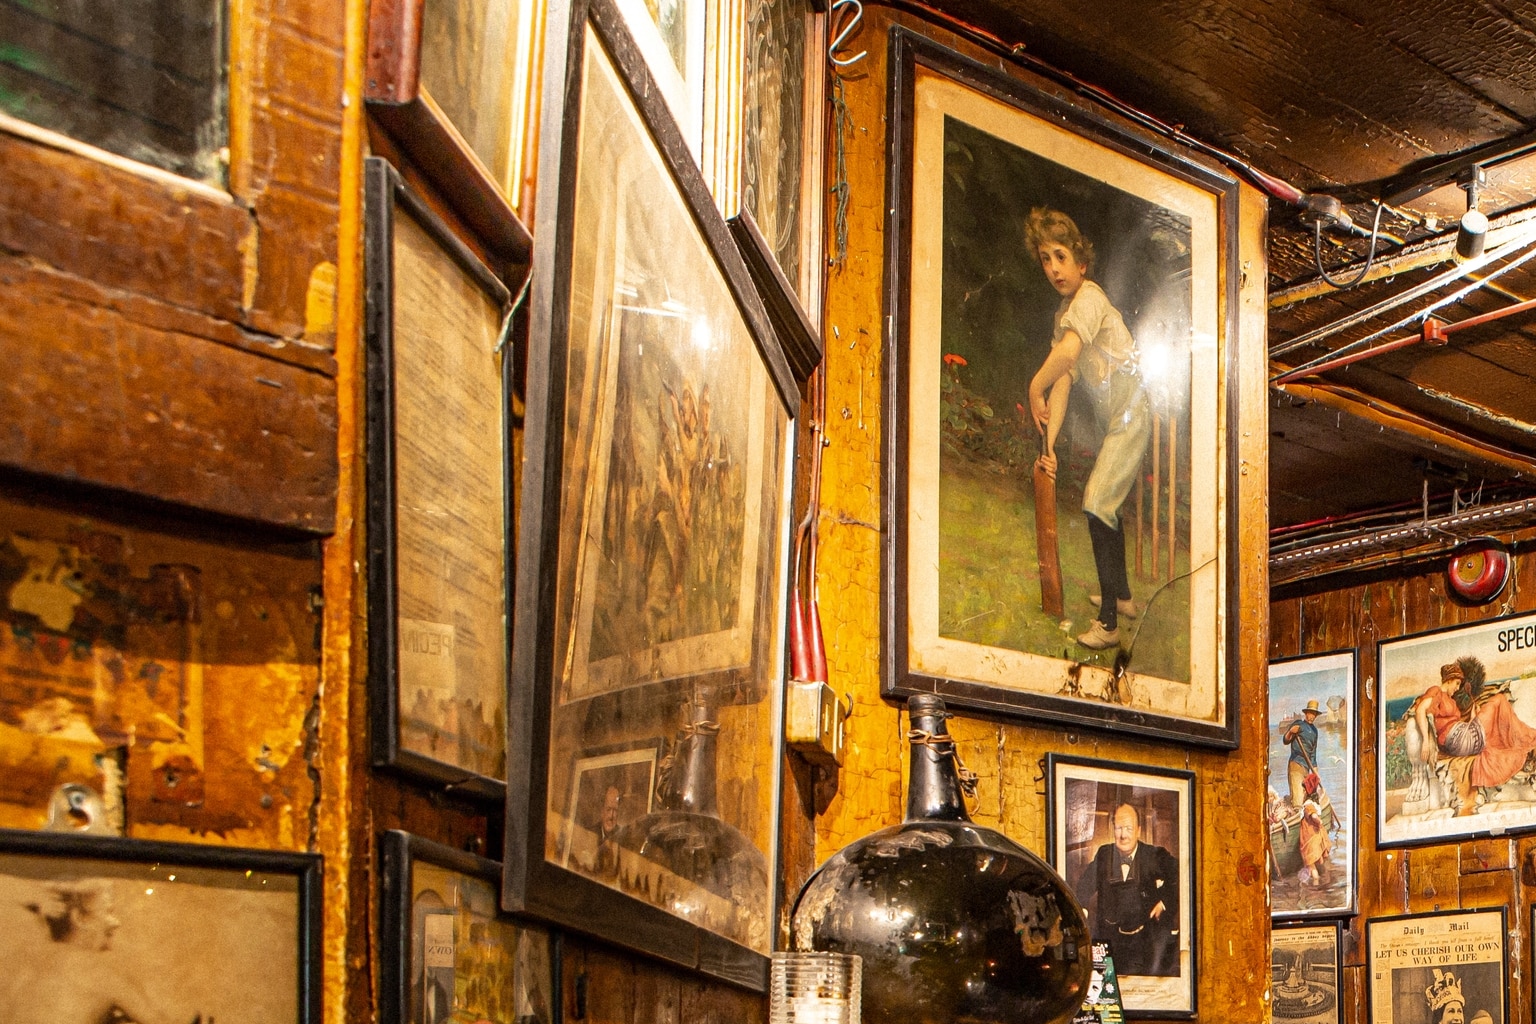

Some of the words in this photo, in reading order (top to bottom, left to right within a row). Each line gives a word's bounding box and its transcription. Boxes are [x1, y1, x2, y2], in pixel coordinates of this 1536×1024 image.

[1403, 926, 1424, 935] Daily
[1449, 922, 1469, 932] Mail
[1376, 950, 1392, 959] LET
[1396, 949, 1407, 957] US
[1411, 946, 1450, 956] CHERISH
[1454, 944, 1474, 953] OUR
[1478, 942, 1500, 951] OWN
[1413, 956, 1433, 965] WAY
[1438, 955, 1451, 963] OF
[1456, 953, 1477, 962] LIFE
